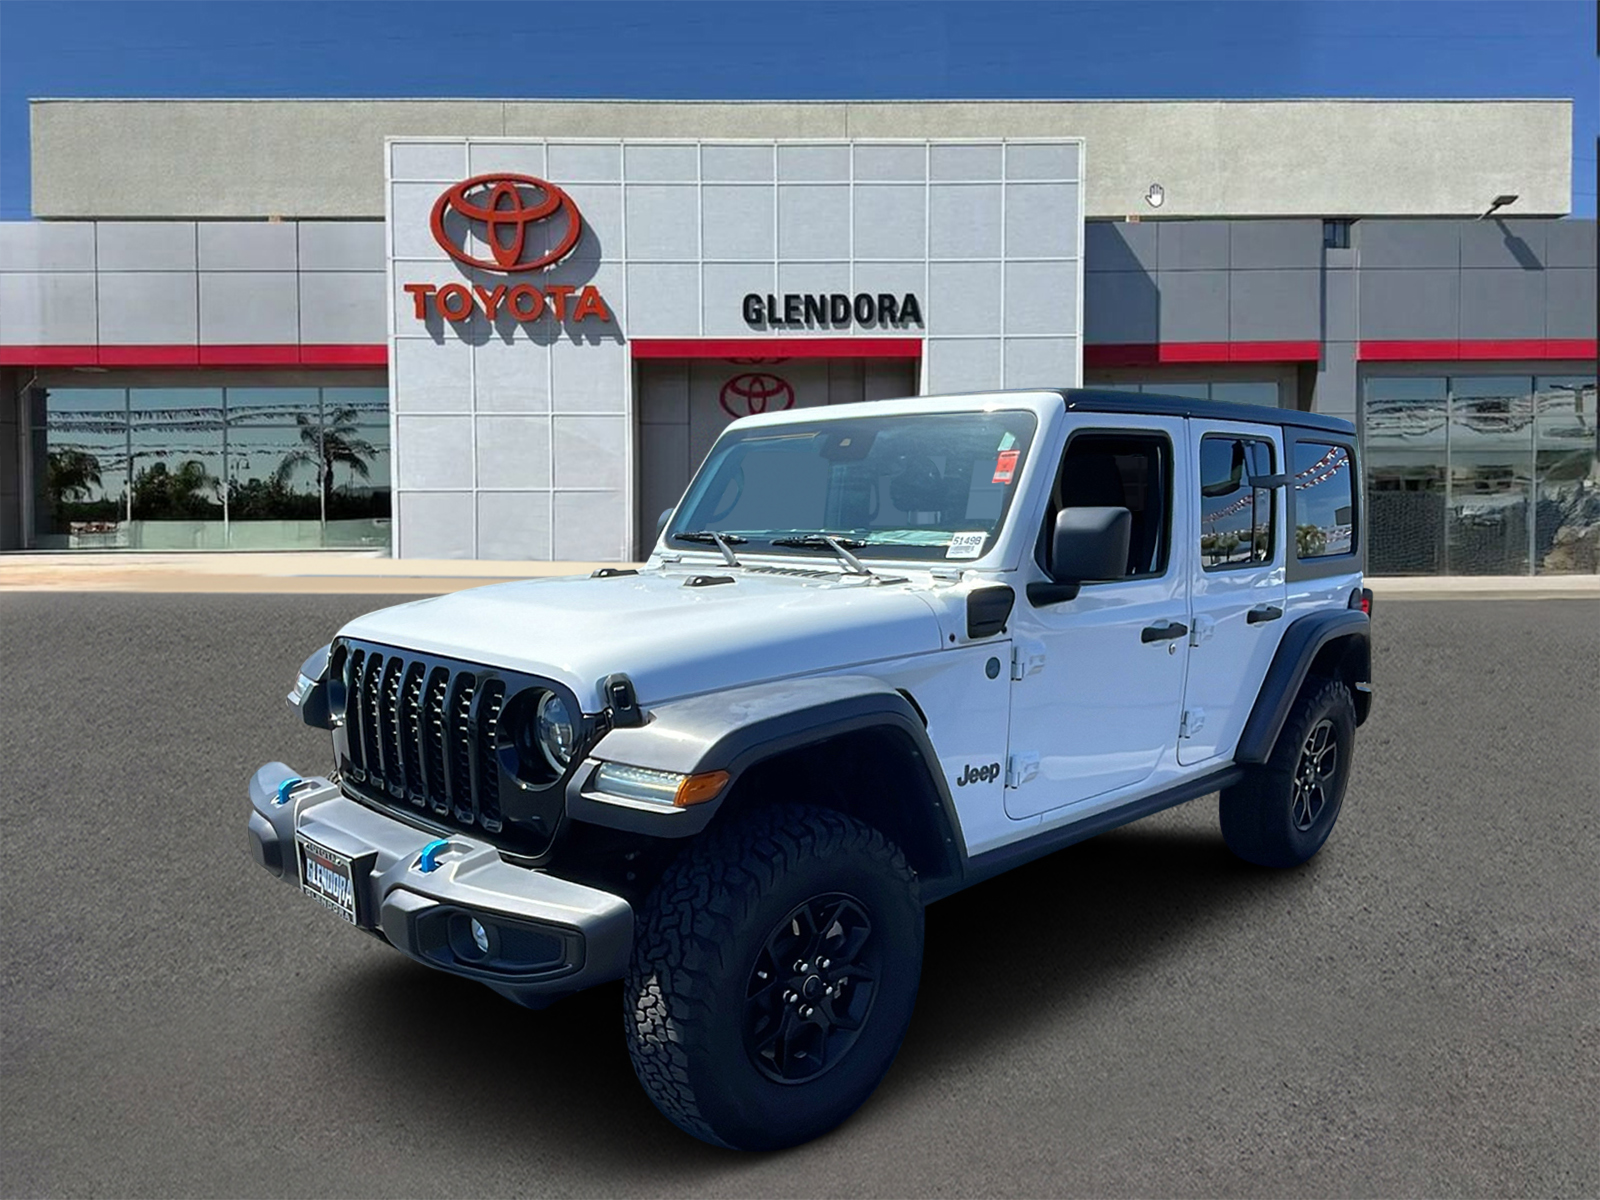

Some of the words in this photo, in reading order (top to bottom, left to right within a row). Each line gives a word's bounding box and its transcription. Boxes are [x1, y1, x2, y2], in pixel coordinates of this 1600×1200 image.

[404, 283, 610, 322] TOYOTA
[743, 293, 922, 325] GLENDORA
[957, 763, 1000, 787] Jeep
